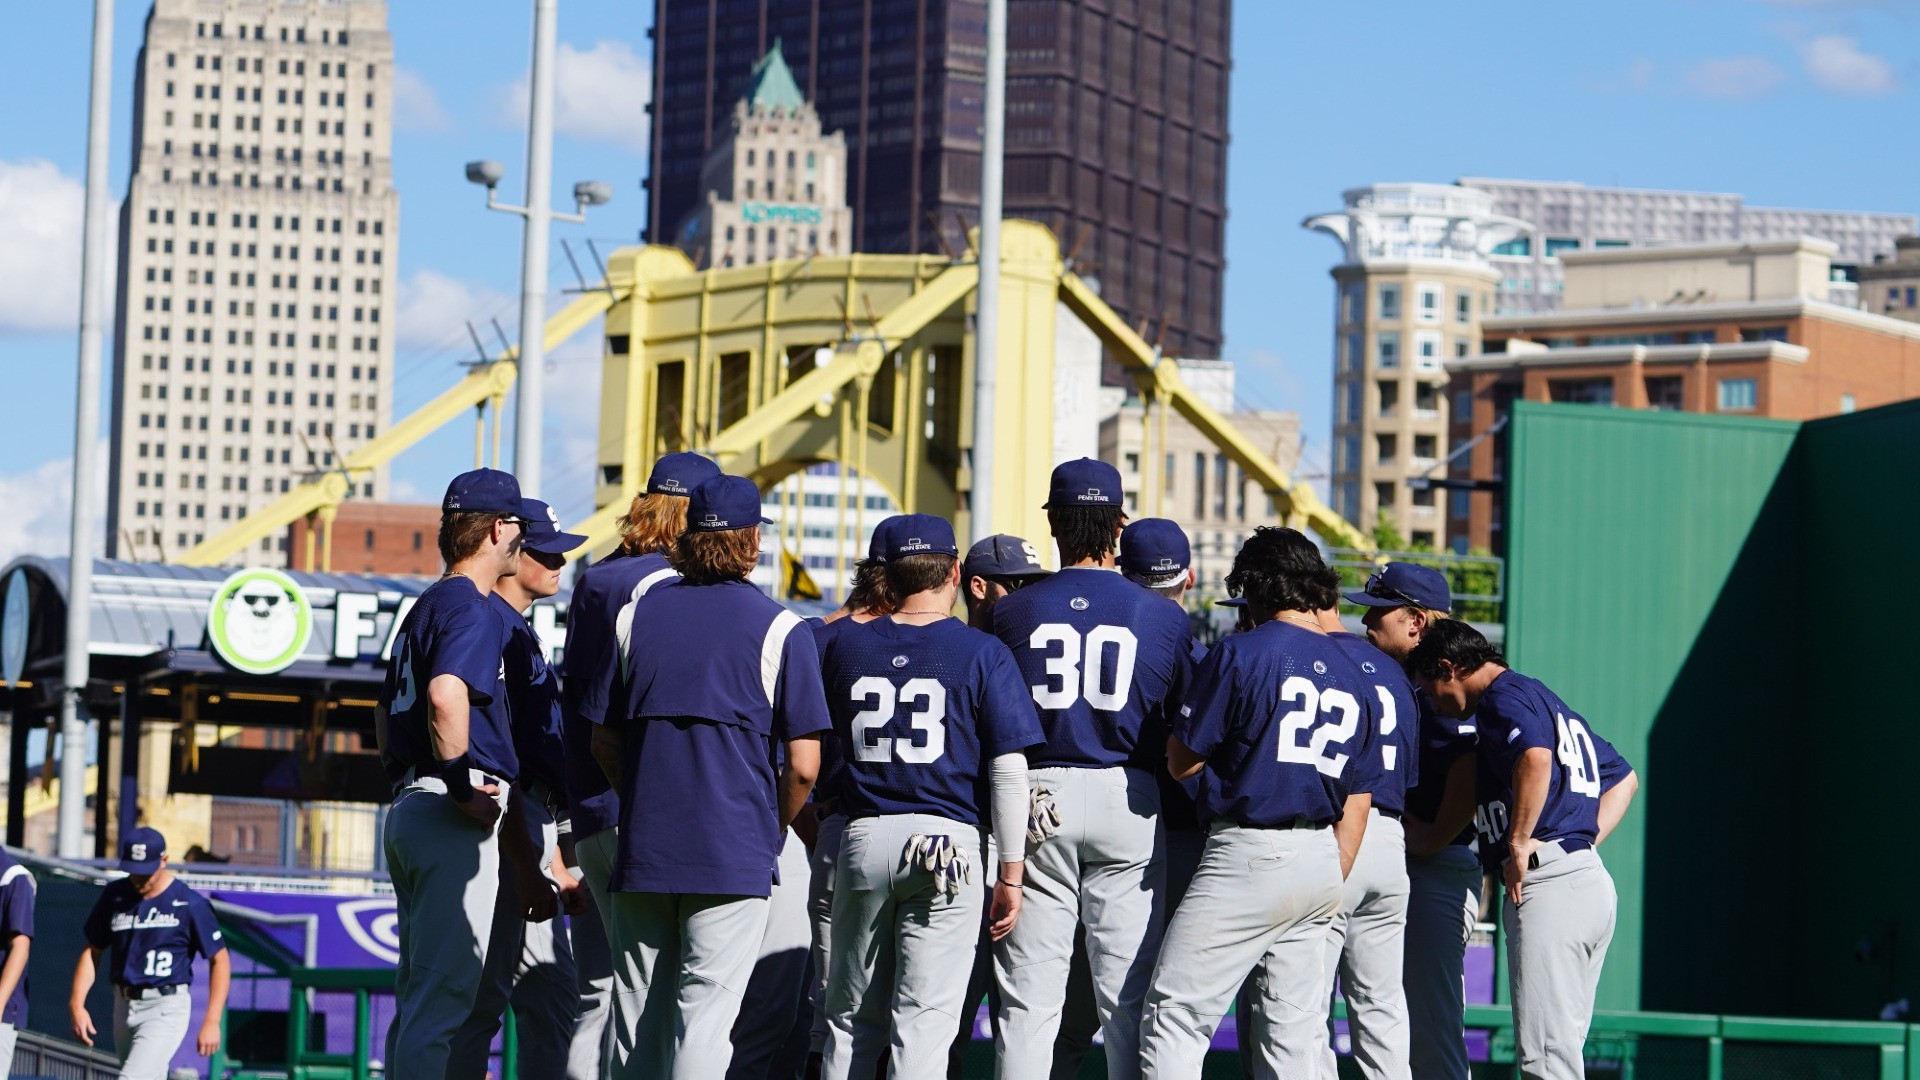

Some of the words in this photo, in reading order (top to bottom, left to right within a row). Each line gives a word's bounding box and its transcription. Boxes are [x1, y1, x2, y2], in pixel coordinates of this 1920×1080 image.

[742, 202, 822, 224] KOPPERS
[1029, 623, 1138, 712] 30
[851, 675, 946, 764] 23
[1277, 676, 1360, 779] 22
[1557, 712, 1600, 799] 40
[131, 843, 147, 861] S
[1476, 800, 1509, 844] 40
[143, 949, 174, 977] 12
